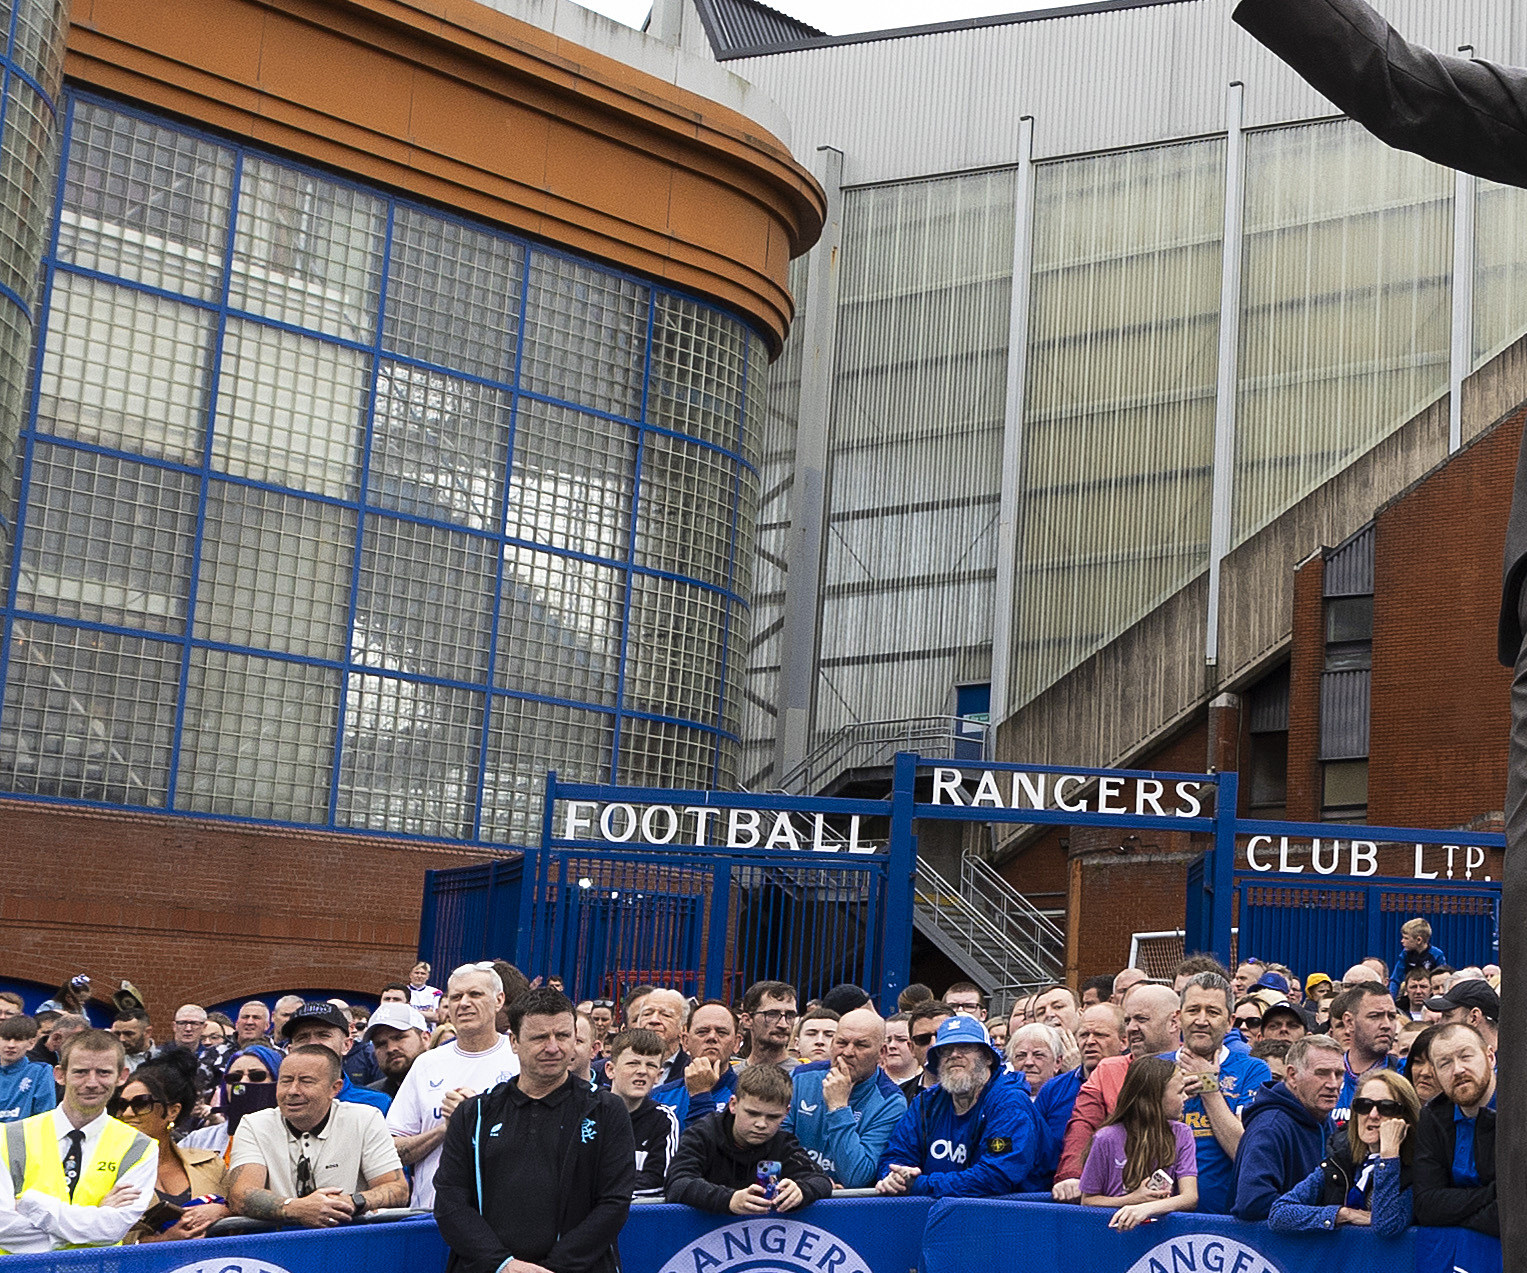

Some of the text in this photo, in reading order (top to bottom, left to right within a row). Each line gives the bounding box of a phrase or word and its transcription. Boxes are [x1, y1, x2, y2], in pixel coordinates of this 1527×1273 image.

[931, 767, 1202, 818] RANGERS
[563, 800, 878, 855] FOOTBALL
[1246, 835, 1379, 877] CLUB
